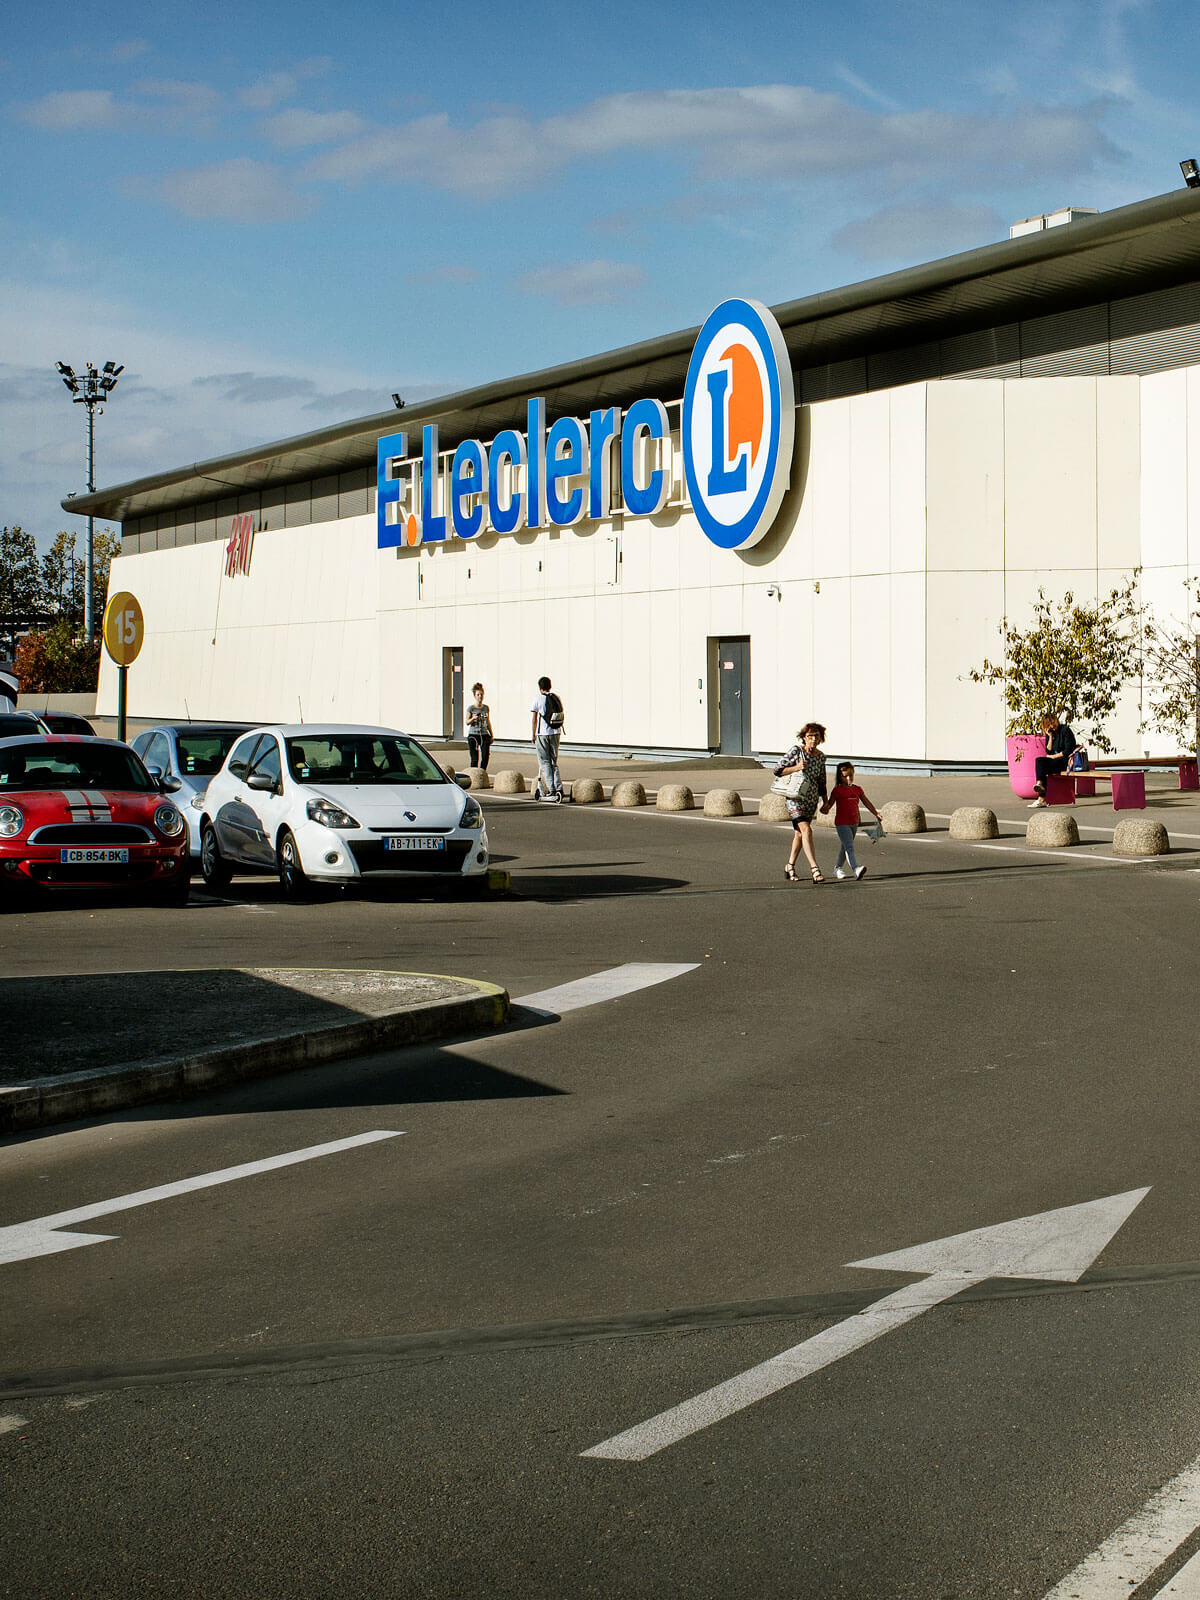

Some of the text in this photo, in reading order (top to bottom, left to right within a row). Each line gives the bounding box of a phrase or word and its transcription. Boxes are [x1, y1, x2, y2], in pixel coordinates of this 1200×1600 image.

[377, 397, 671, 549] E.Leclerc
[114, 609, 137, 645] 15
[390, 838, 438, 849] AB-711-EK
[69, 850, 121, 861] CB-854-BK
